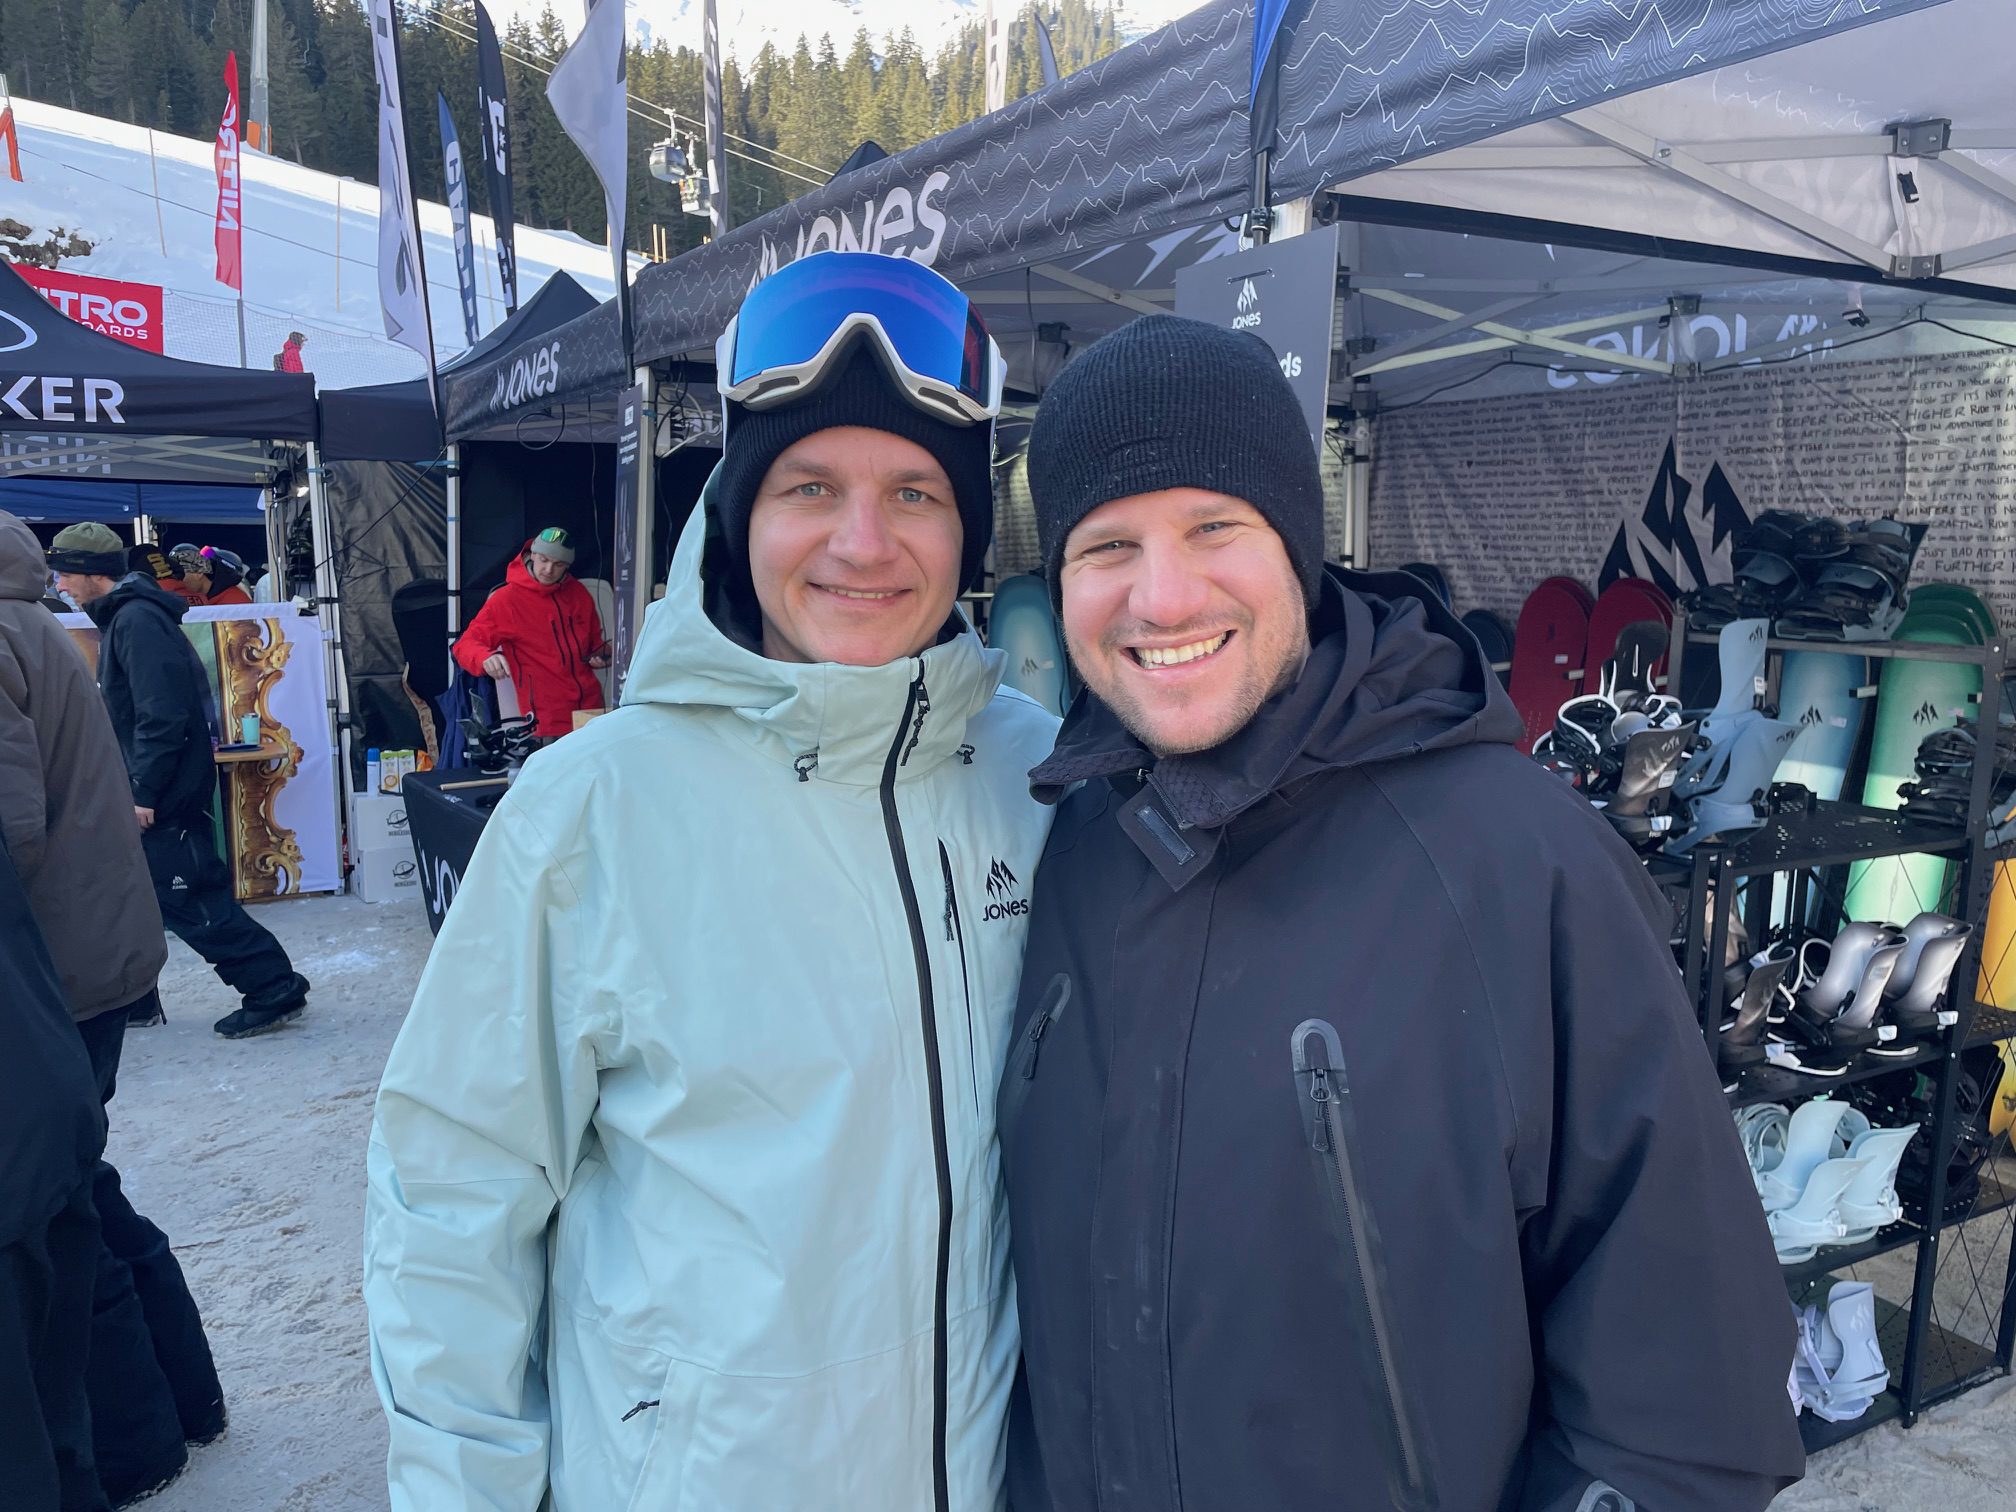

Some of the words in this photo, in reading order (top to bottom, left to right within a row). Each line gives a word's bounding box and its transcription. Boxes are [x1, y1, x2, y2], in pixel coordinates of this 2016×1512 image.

[1905, 405, 1966, 421] HIGHER
[1920, 449, 1958, 462] VOTE
[1920, 546, 1947, 558] JUST
[1951, 546, 1973, 558] BAD
[1935, 560, 2005, 573] FURTHER
